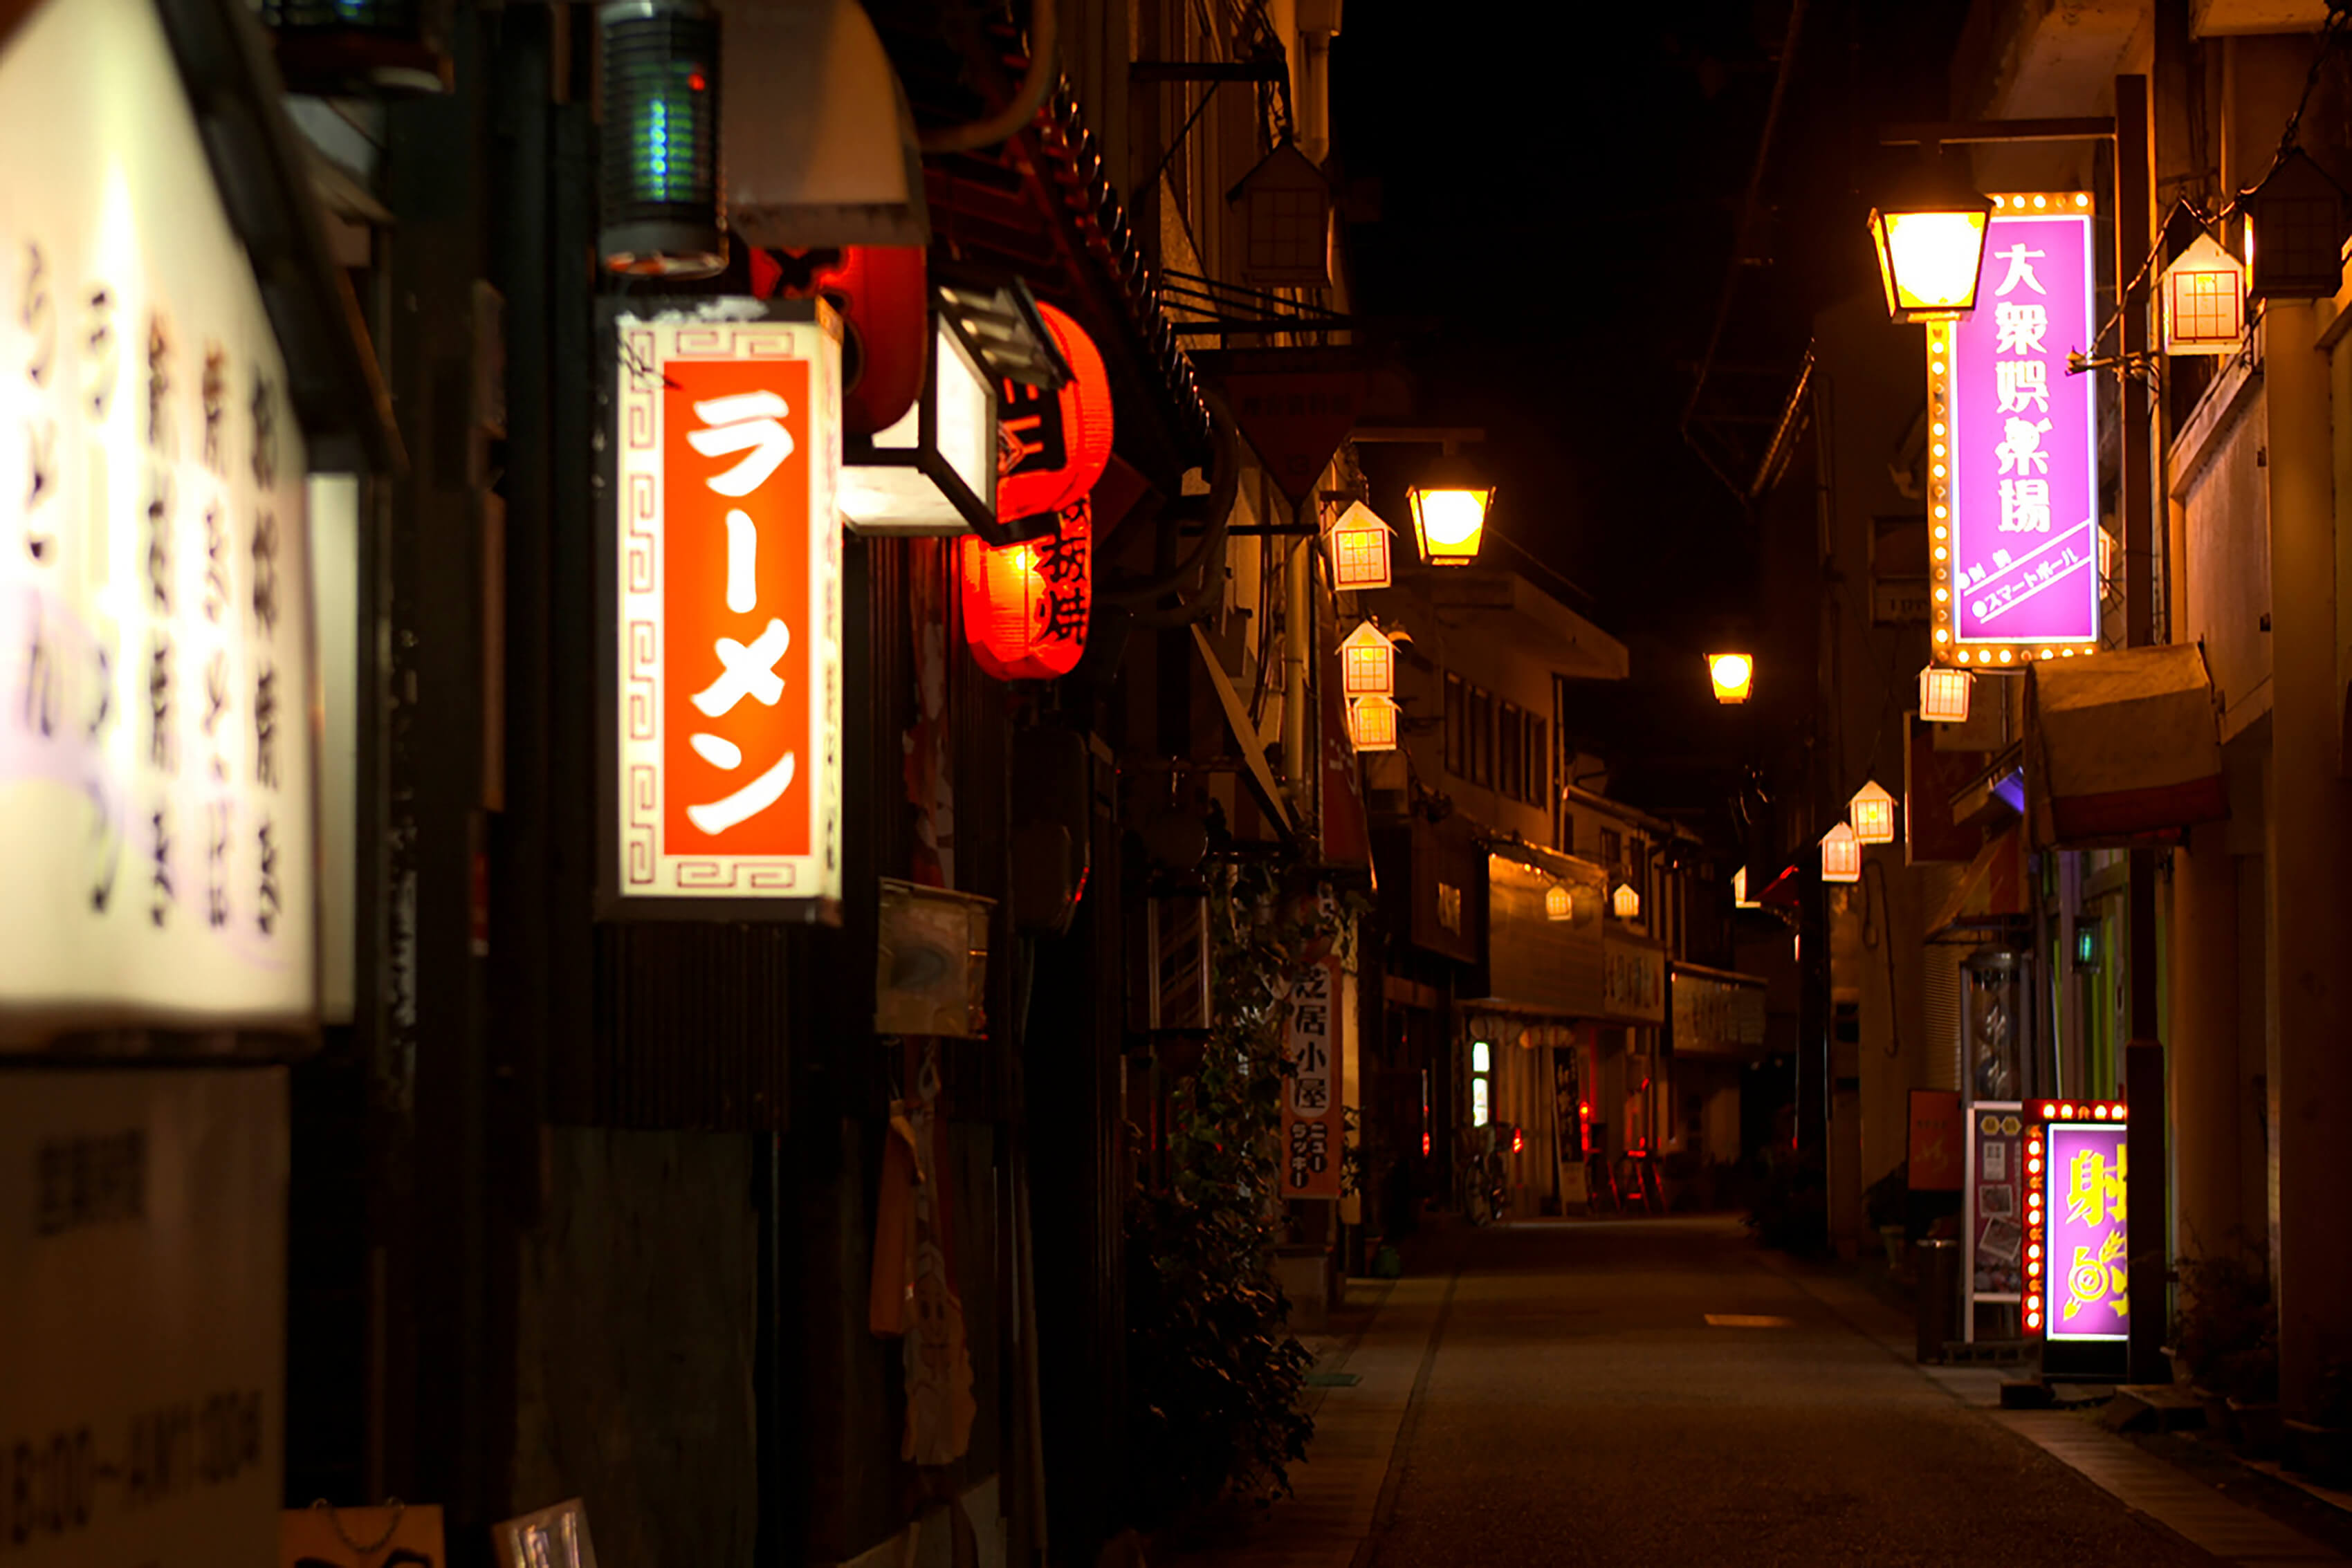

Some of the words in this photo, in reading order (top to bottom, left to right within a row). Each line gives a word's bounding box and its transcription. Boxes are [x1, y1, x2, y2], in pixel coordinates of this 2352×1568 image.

[1994, 243, 2052, 533] 大衆娯楽場
[687, 390, 795, 835] ラーメン
[1984, 547, 2079, 612] スマートボール
[1295, 967, 1327, 1108] 芝居小屋
